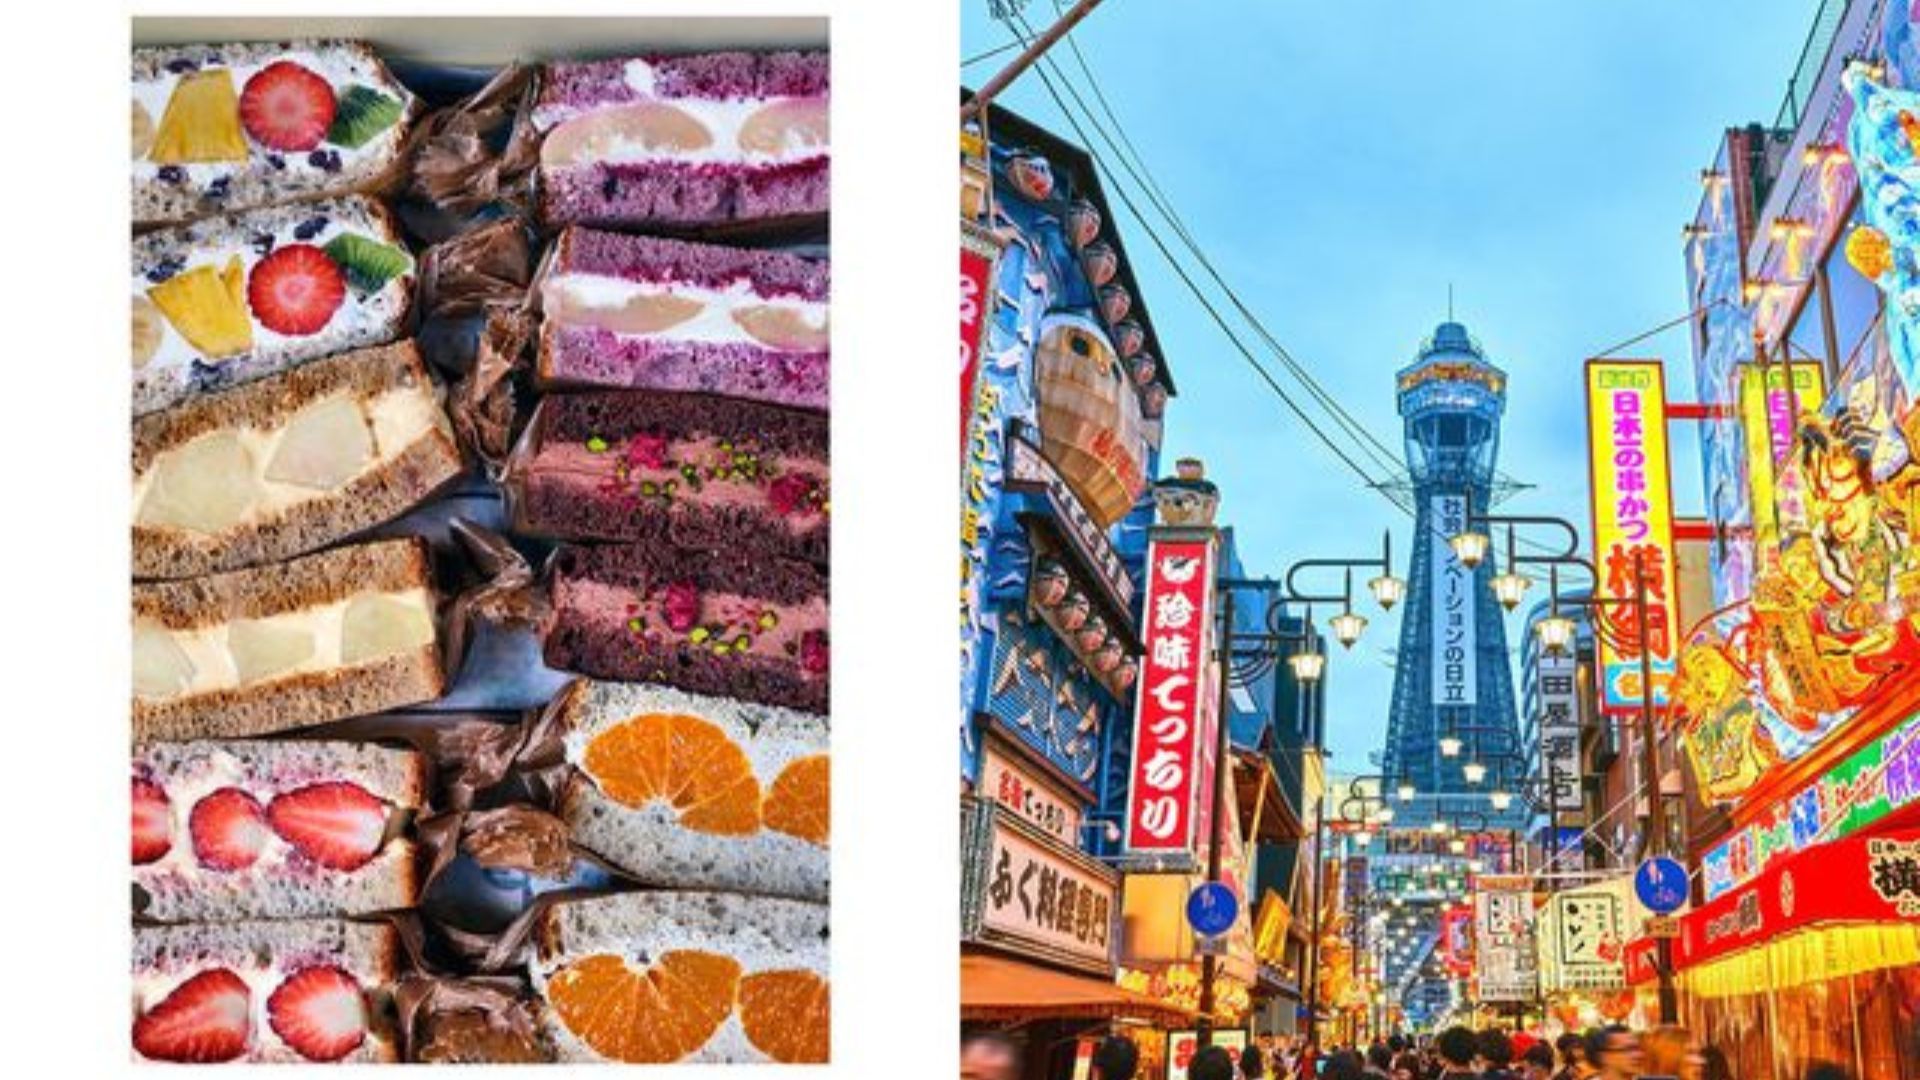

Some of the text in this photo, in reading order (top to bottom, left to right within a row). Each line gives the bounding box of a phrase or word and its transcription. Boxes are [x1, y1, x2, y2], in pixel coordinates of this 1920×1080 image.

[1613, 391, 1648, 540] 日本一の串かつ
[1140, 592, 1193, 839] 珍味てっちり
[1541, 642, 1579, 797] 田屋酒店
